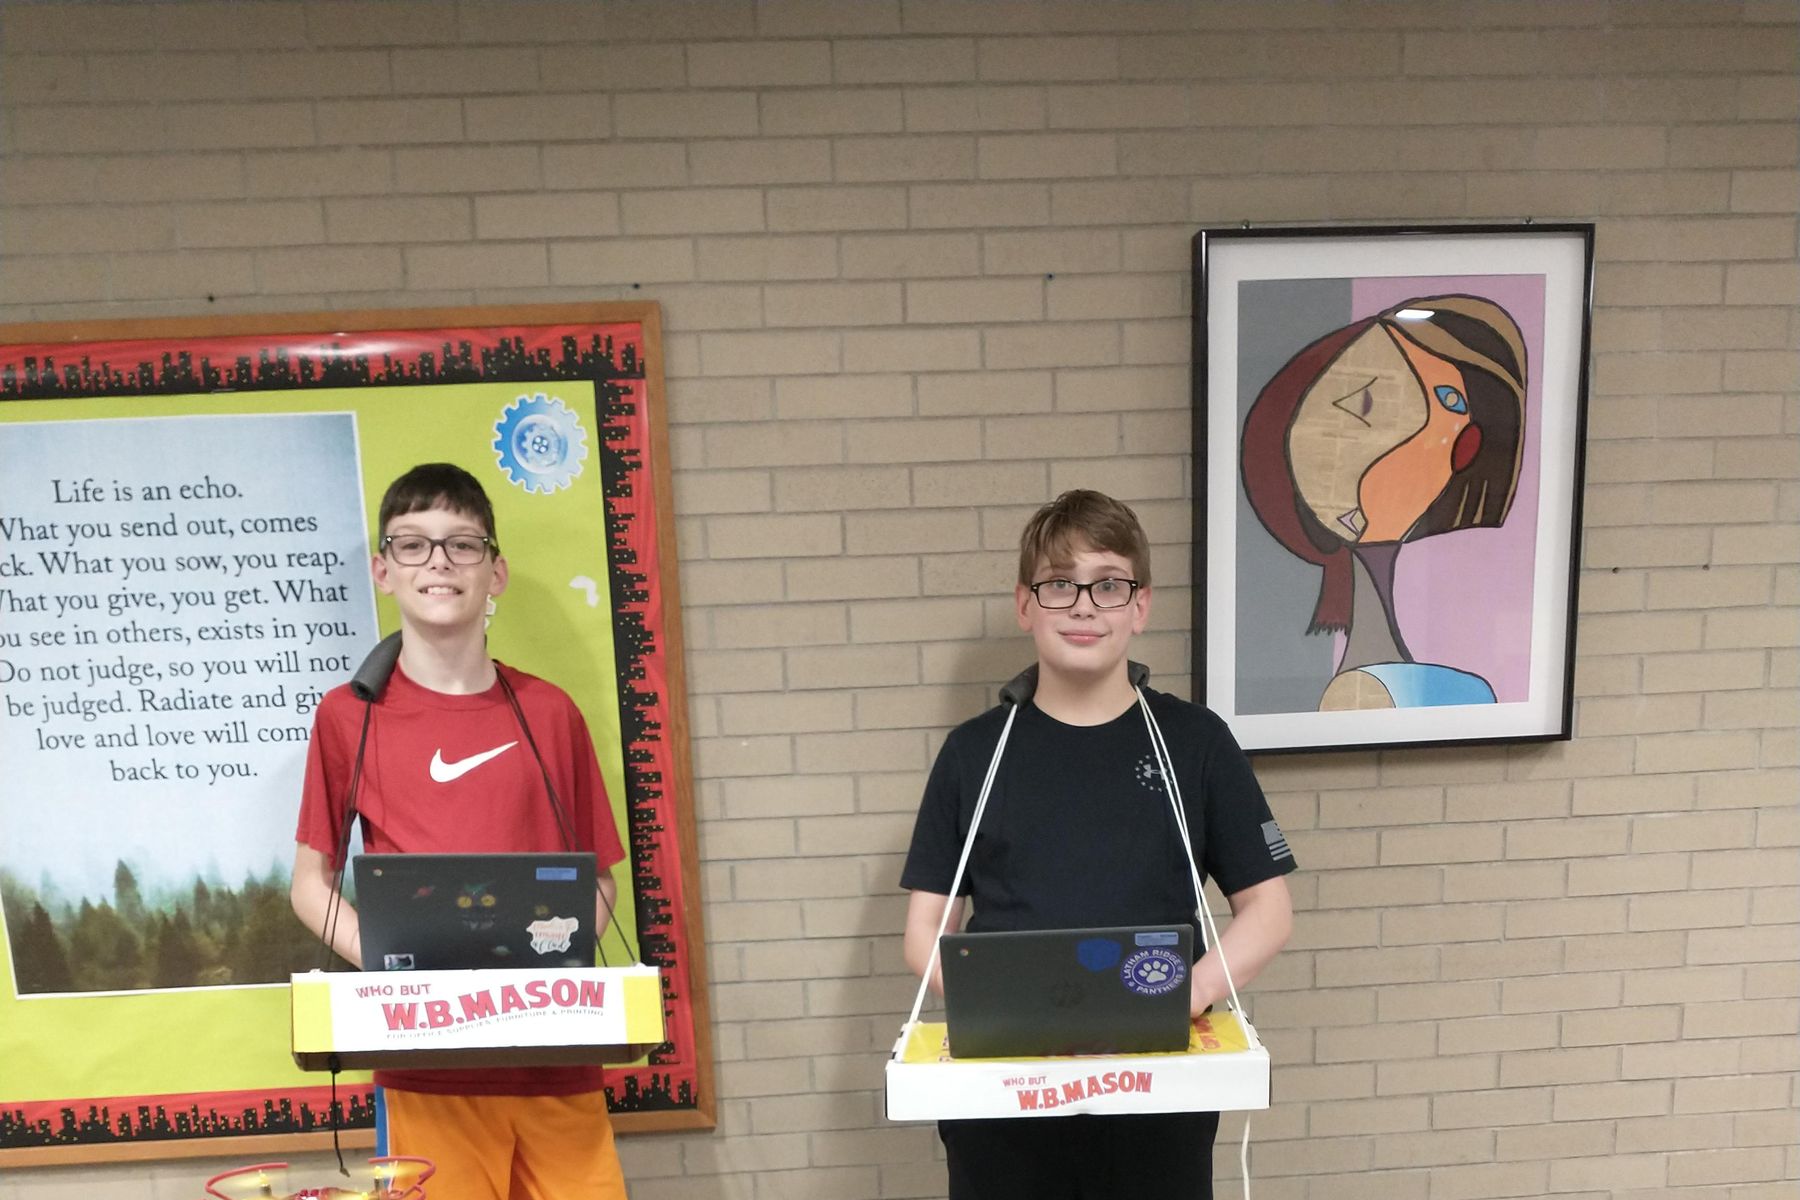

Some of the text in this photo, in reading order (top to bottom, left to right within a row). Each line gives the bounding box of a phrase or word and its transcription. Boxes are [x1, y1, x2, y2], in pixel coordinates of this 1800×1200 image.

[51, 475, 243, 504] Life is an echo.
[66, 520, 112, 546] you
[120, 513, 178, 538] send
[186, 516, 235, 539] out,
[240, 515, 318, 535] comes
[38, 551, 113, 575] What
[121, 555, 166, 580] you
[175, 554, 228, 574] sow,
[235, 552, 278, 577] you
[286, 551, 345, 575] reap.
[0, 579, 348, 618] hat you give, you get. What
[30, 631, 66, 647] see
[73, 624, 98, 645] in
[106, 620, 191, 646] others,
[198, 618, 265, 641] exists
[272, 617, 297, 639] in
[304, 619, 357, 645] you.
[0, 650, 351, 688] Do not judge, so you will not
[5, 685, 323, 723] be judged. Radiate and gi
[36, 721, 311, 751] love and love will com
[109, 758, 258, 786] back to you.
[1152, 949, 1182, 968] RIDGE
[356, 983, 432, 999] WHO BUT
[381, 978, 606, 1031] W.B.MASON
[1002, 1076, 1047, 1087] WHO BUT
[1016, 1070, 1154, 1111] W.B.MASON
